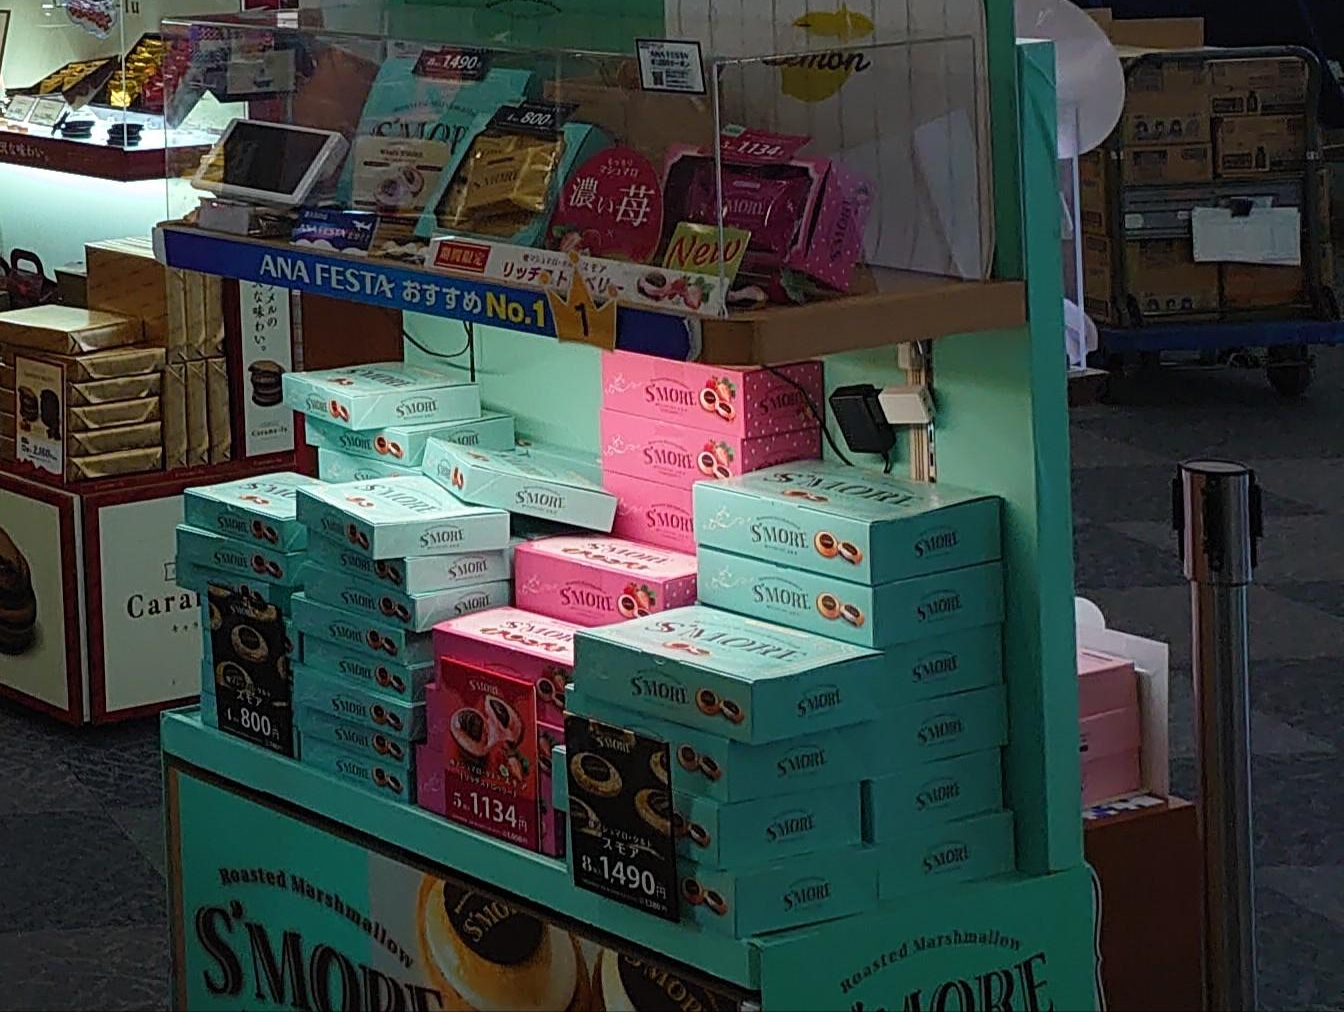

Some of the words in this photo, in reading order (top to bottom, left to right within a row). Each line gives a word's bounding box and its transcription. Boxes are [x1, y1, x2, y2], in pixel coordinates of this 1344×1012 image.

[570, 177, 656, 228] 濃い苺
[666, 236, 742, 269] New
[260, 252, 311, 284] ANA
[314, 262, 396, 299] FESTA
[402, 279, 482, 314] おすすめ
[485, 291, 546, 327] No.1
[575, 303, 589, 337] 1
[396, 400, 438, 418] S'MORE
[645, 385, 697, 408] S'MORE
[643, 447, 693, 468] S'MORE
[516, 490, 565, 508] S'MORE
[420, 529, 464, 547] S'MORE
[751, 523, 808, 548] S'MORE
[448, 560, 486, 579] S'MORE
[560, 587, 613, 611] S'MORE
[752, 584, 810, 610] S'MORE
[630, 677, 688, 705] S'MORE
[219, 868, 287, 889] Roasted
[291, 875, 414, 969] Marshmallow
[840, 943, 911, 995] Roasted
[911, 928, 1022, 953] Marshmallow
